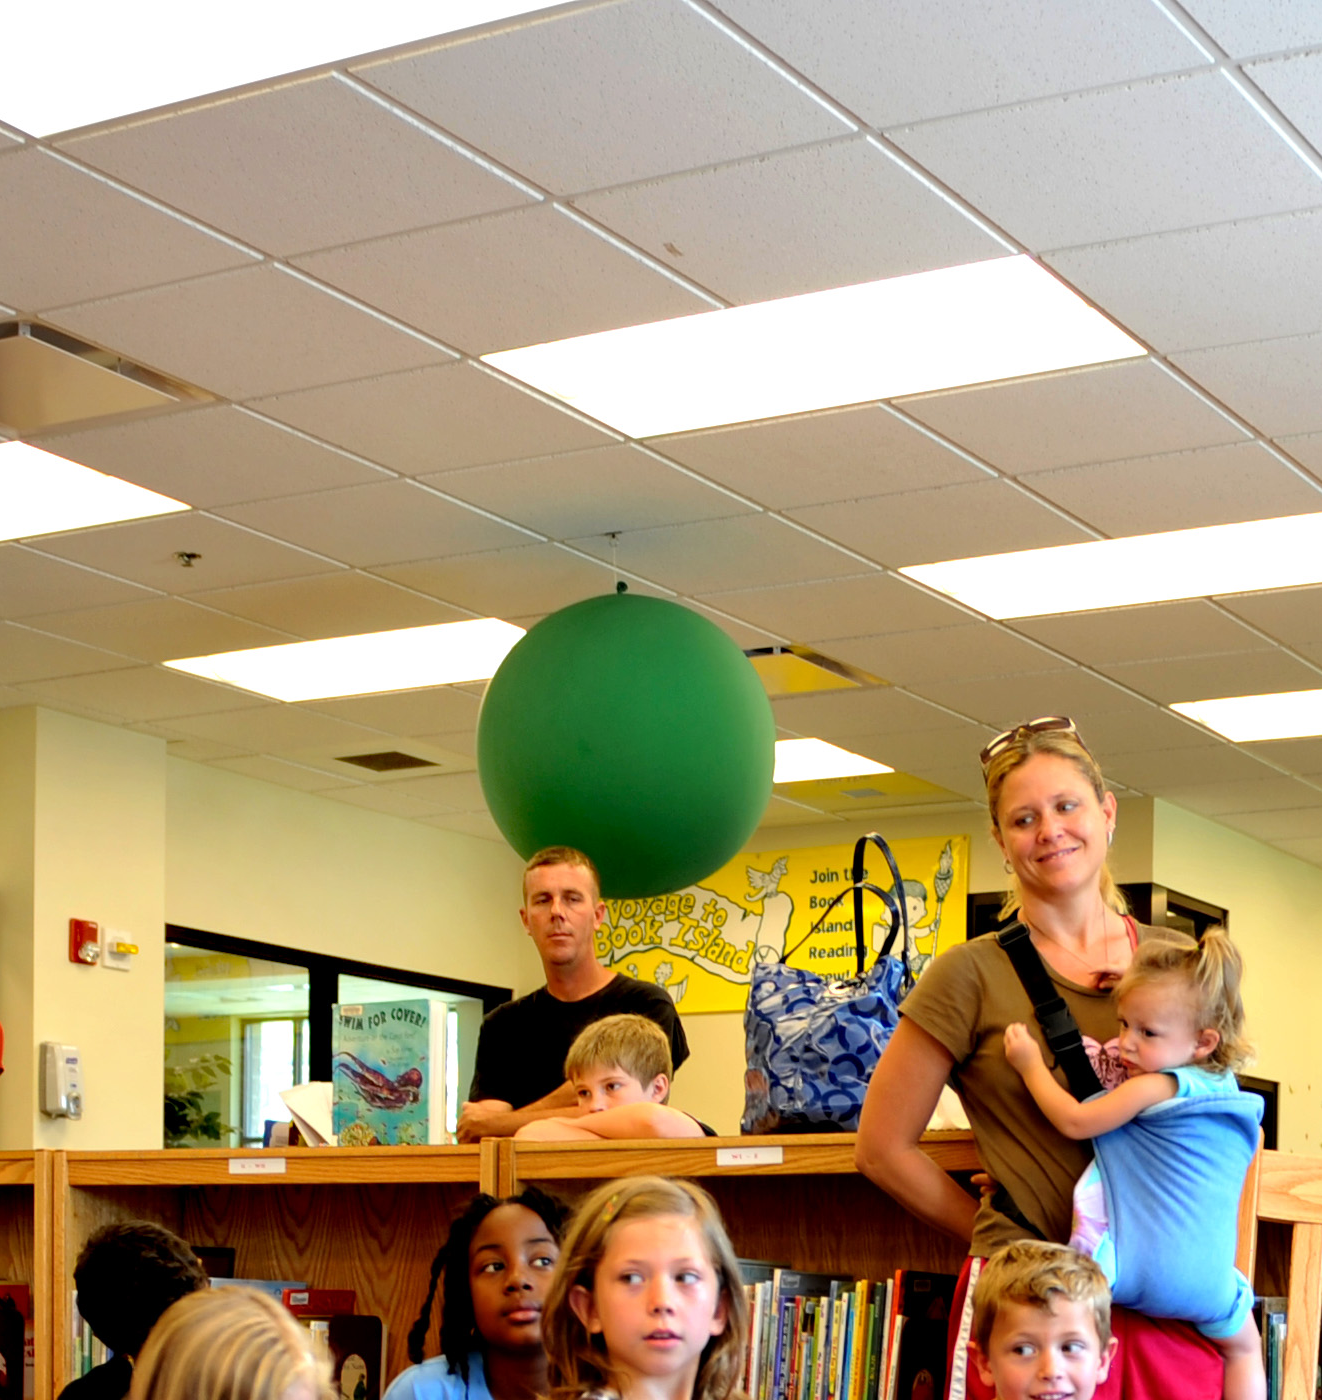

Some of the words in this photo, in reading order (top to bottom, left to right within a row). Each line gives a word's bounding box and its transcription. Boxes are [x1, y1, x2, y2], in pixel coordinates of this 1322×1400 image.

[809, 867, 839, 884] Join
[844, 868, 869, 882] te
[605, 893, 695, 929] Voyage
[701, 898, 728, 928] to
[593, 916, 663, 959] Book
[669, 916, 756, 975] Island
[339, 1015, 364, 1031] SWIM
[368, 1011, 386, 1029] FOR
[390, 1007, 427, 1028] COVER!
